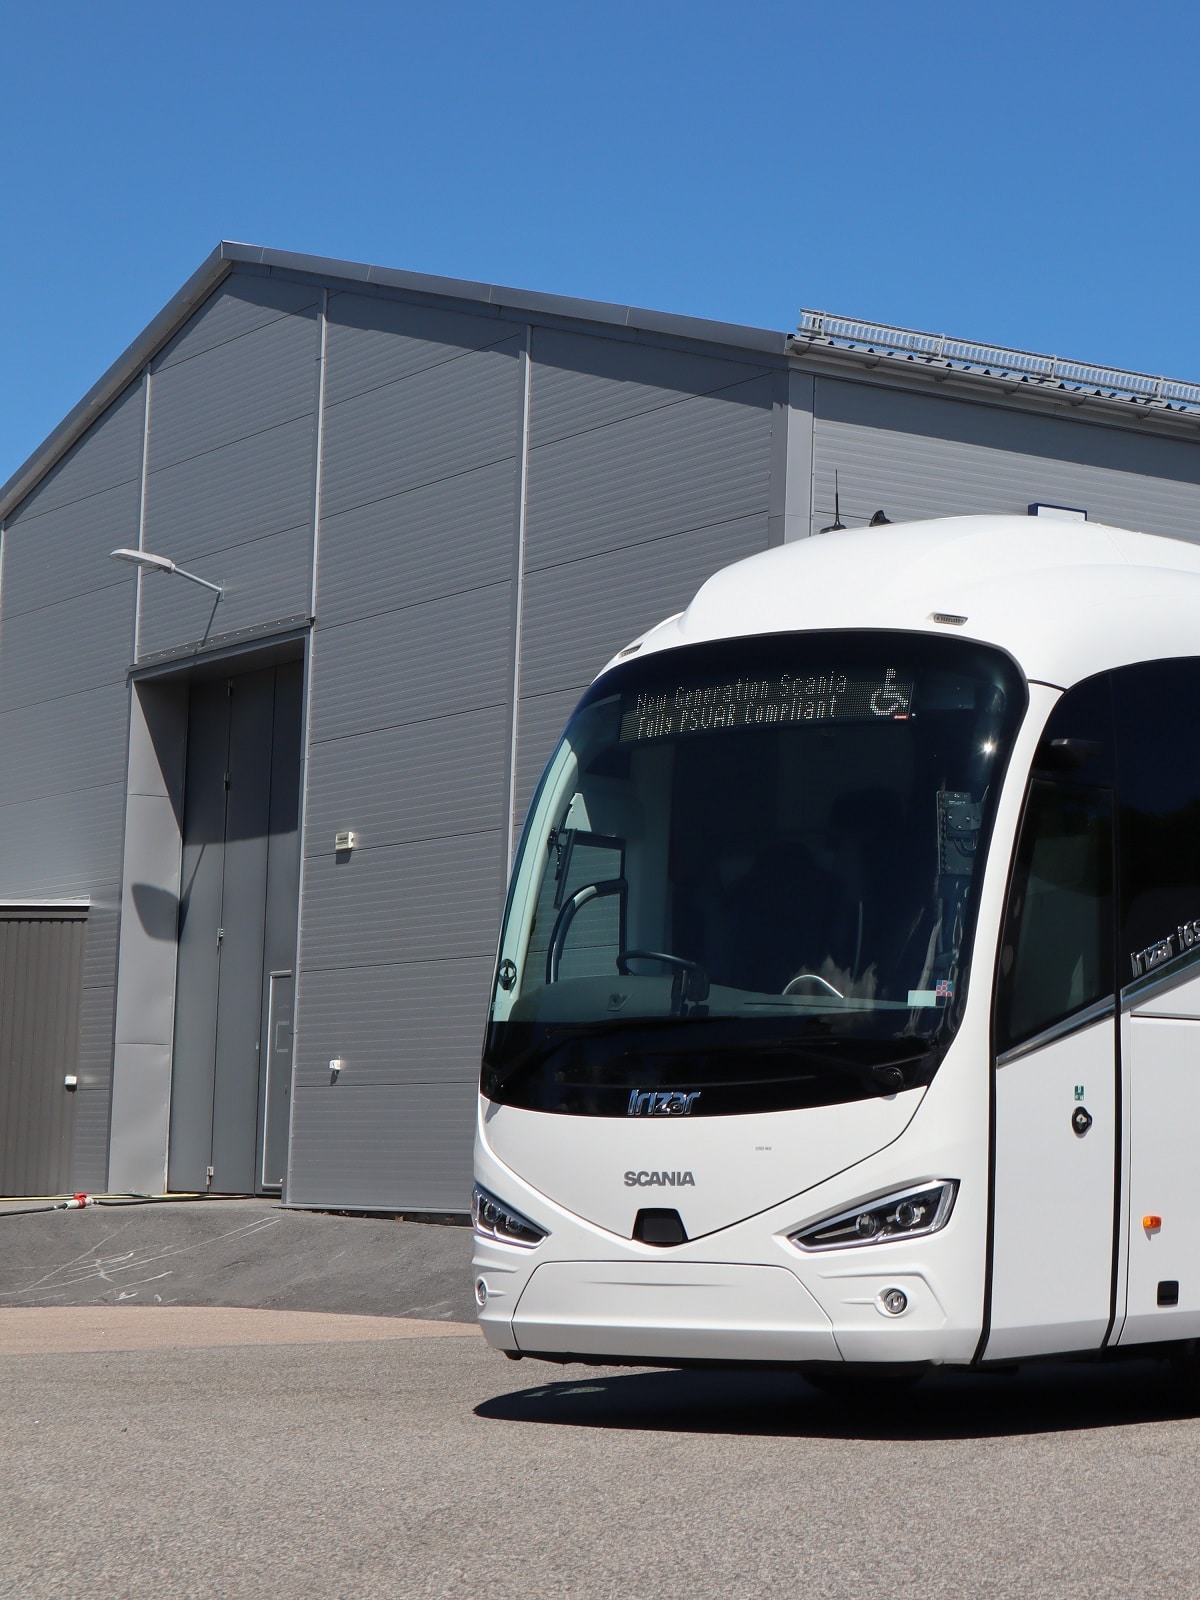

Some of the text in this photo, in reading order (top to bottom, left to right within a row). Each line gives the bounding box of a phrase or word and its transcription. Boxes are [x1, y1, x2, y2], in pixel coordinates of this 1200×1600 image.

[636, 671, 846, 714] New Generation Scania
[745, 695, 836, 724] Compliant
[627, 1089, 701, 1115] Irizar
[624, 1171, 695, 1187] SCANIA
